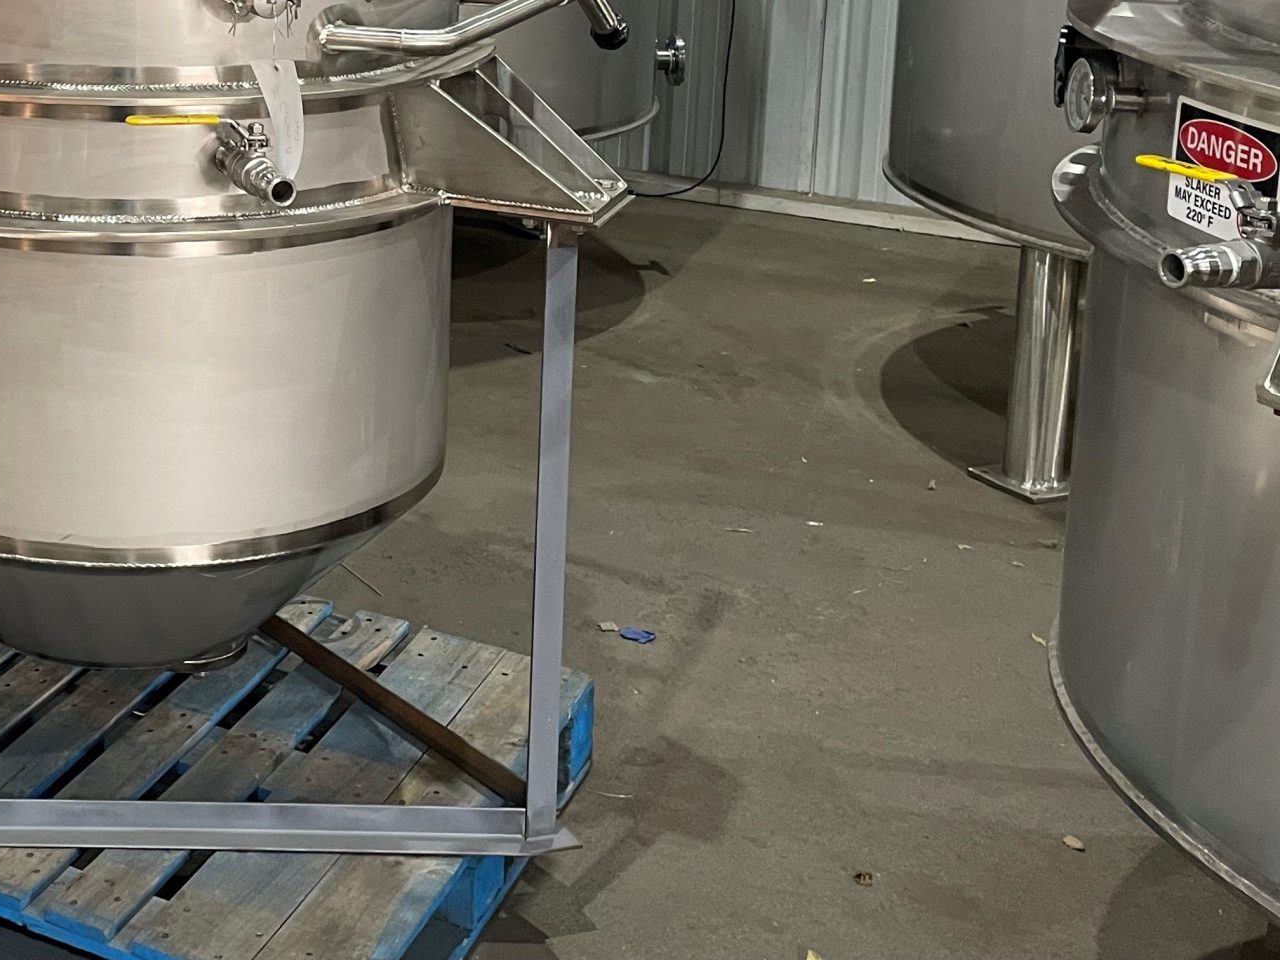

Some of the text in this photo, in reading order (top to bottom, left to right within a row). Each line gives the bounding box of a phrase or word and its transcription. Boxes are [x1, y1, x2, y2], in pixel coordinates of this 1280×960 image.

[1187, 126, 1263, 174] DANGER
[1174, 185, 1232, 220] MAY EXCEED
[1185, 176, 1221, 201] SLAKER
[1207, 215, 1214, 228] F
